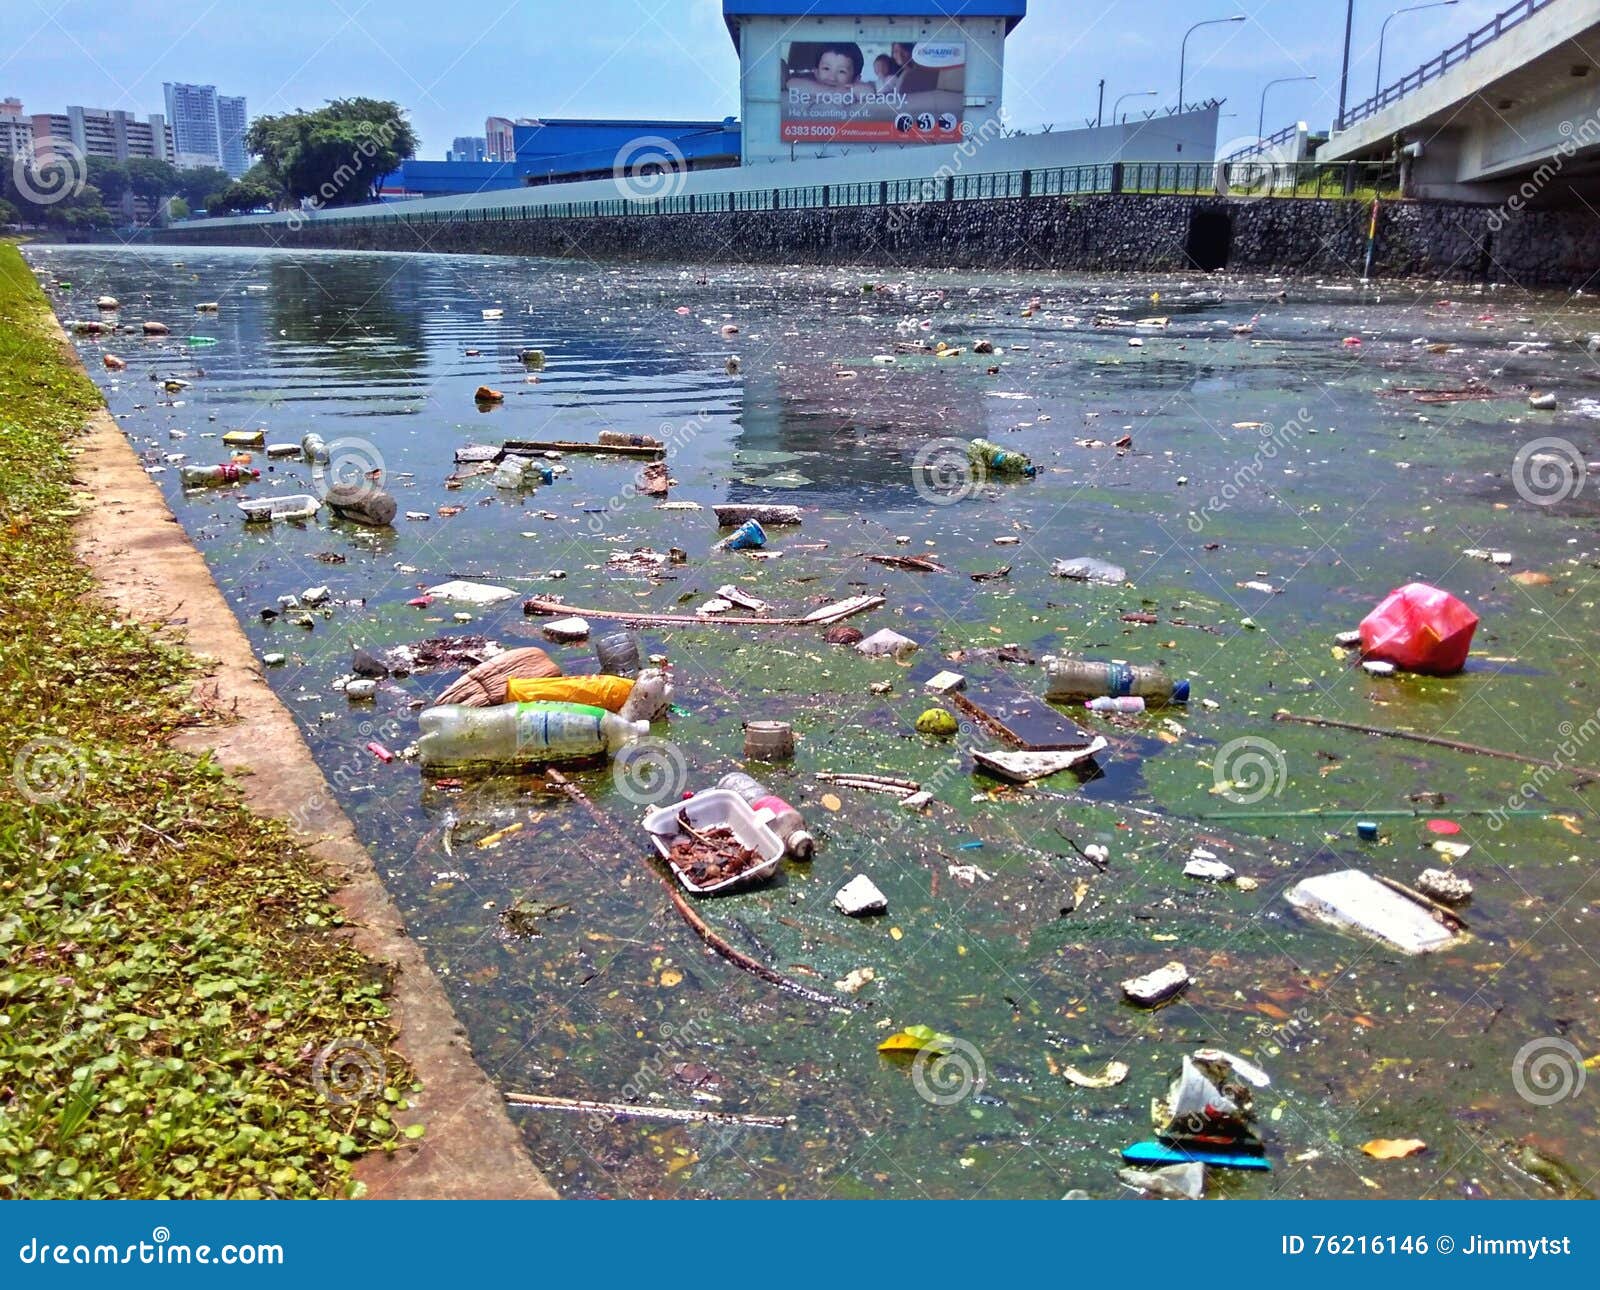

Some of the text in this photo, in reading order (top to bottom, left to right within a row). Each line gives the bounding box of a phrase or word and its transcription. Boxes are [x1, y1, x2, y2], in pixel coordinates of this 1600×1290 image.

[789, 87, 908, 110] Be road ready.
[810, 108, 847, 119] counting
[811, 126, 836, 136] 5000
